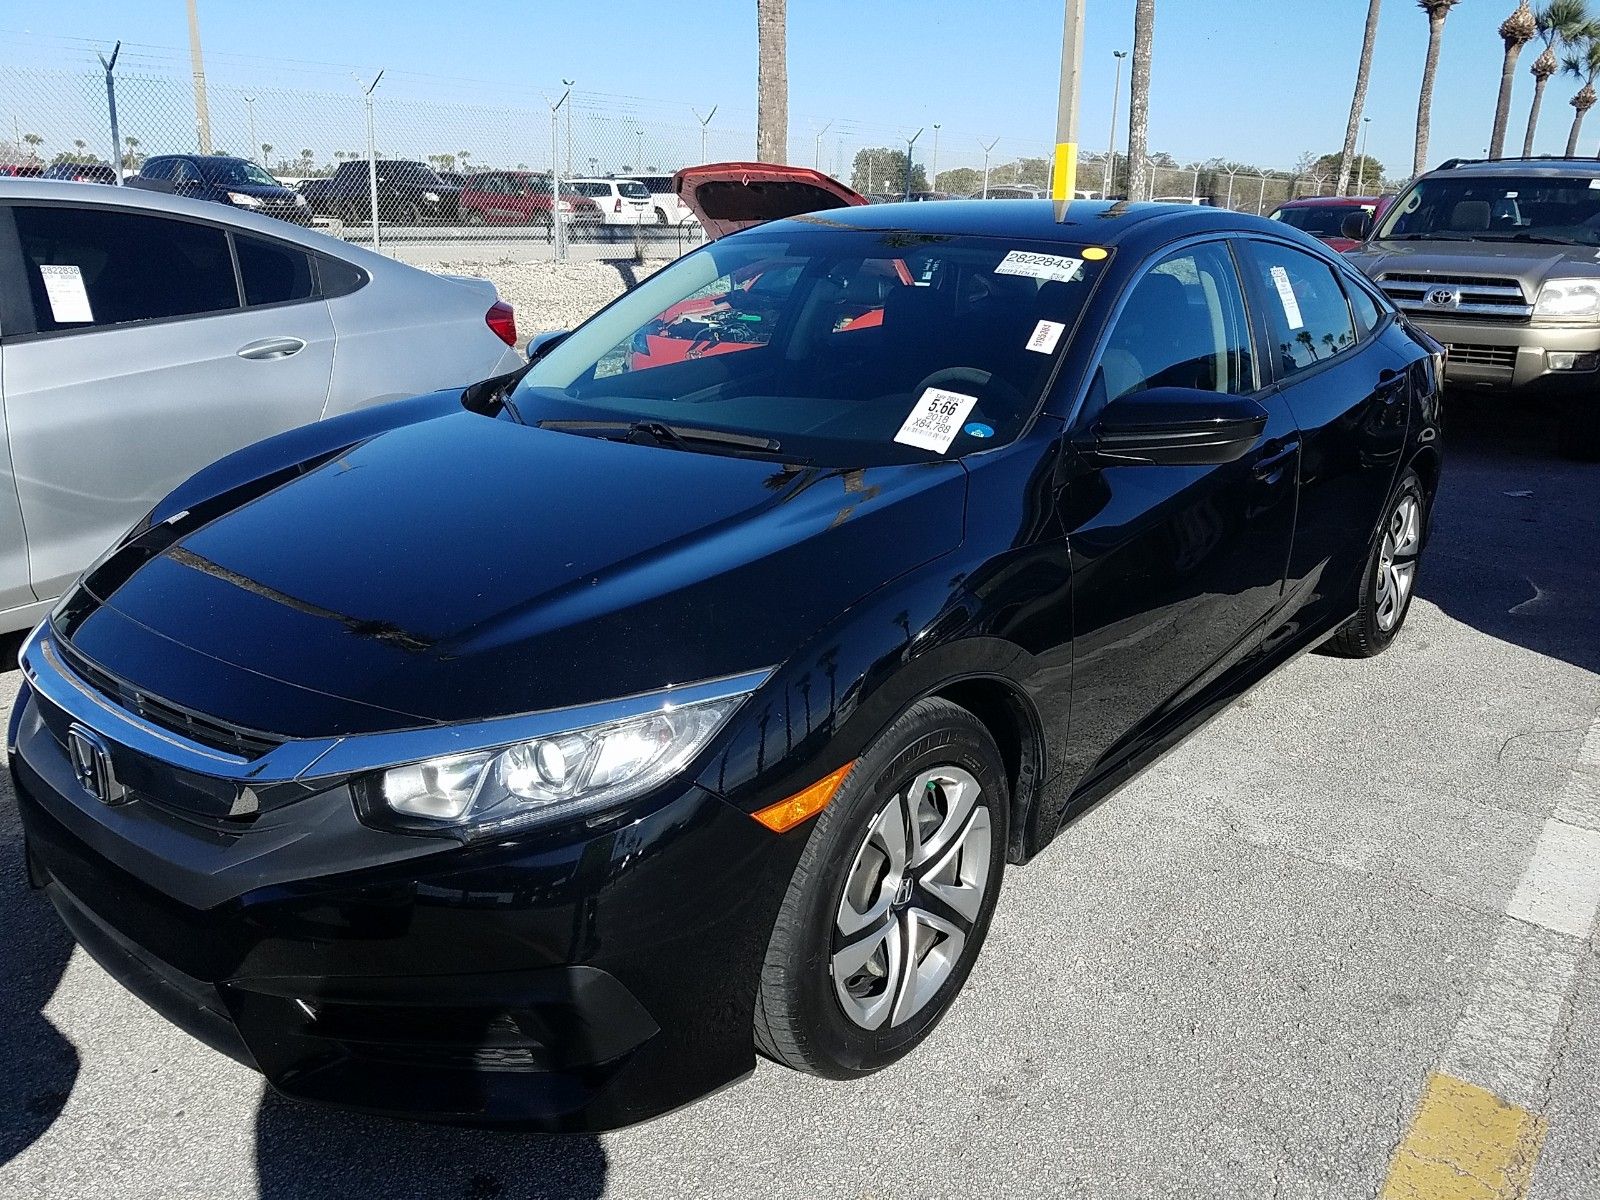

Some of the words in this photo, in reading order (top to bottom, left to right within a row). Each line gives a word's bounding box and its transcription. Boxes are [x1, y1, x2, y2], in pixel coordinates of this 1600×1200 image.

[1006, 252, 1073, 270] 2822843
[928, 398, 958, 416] 5:66
[926, 412, 950, 424] 2018
